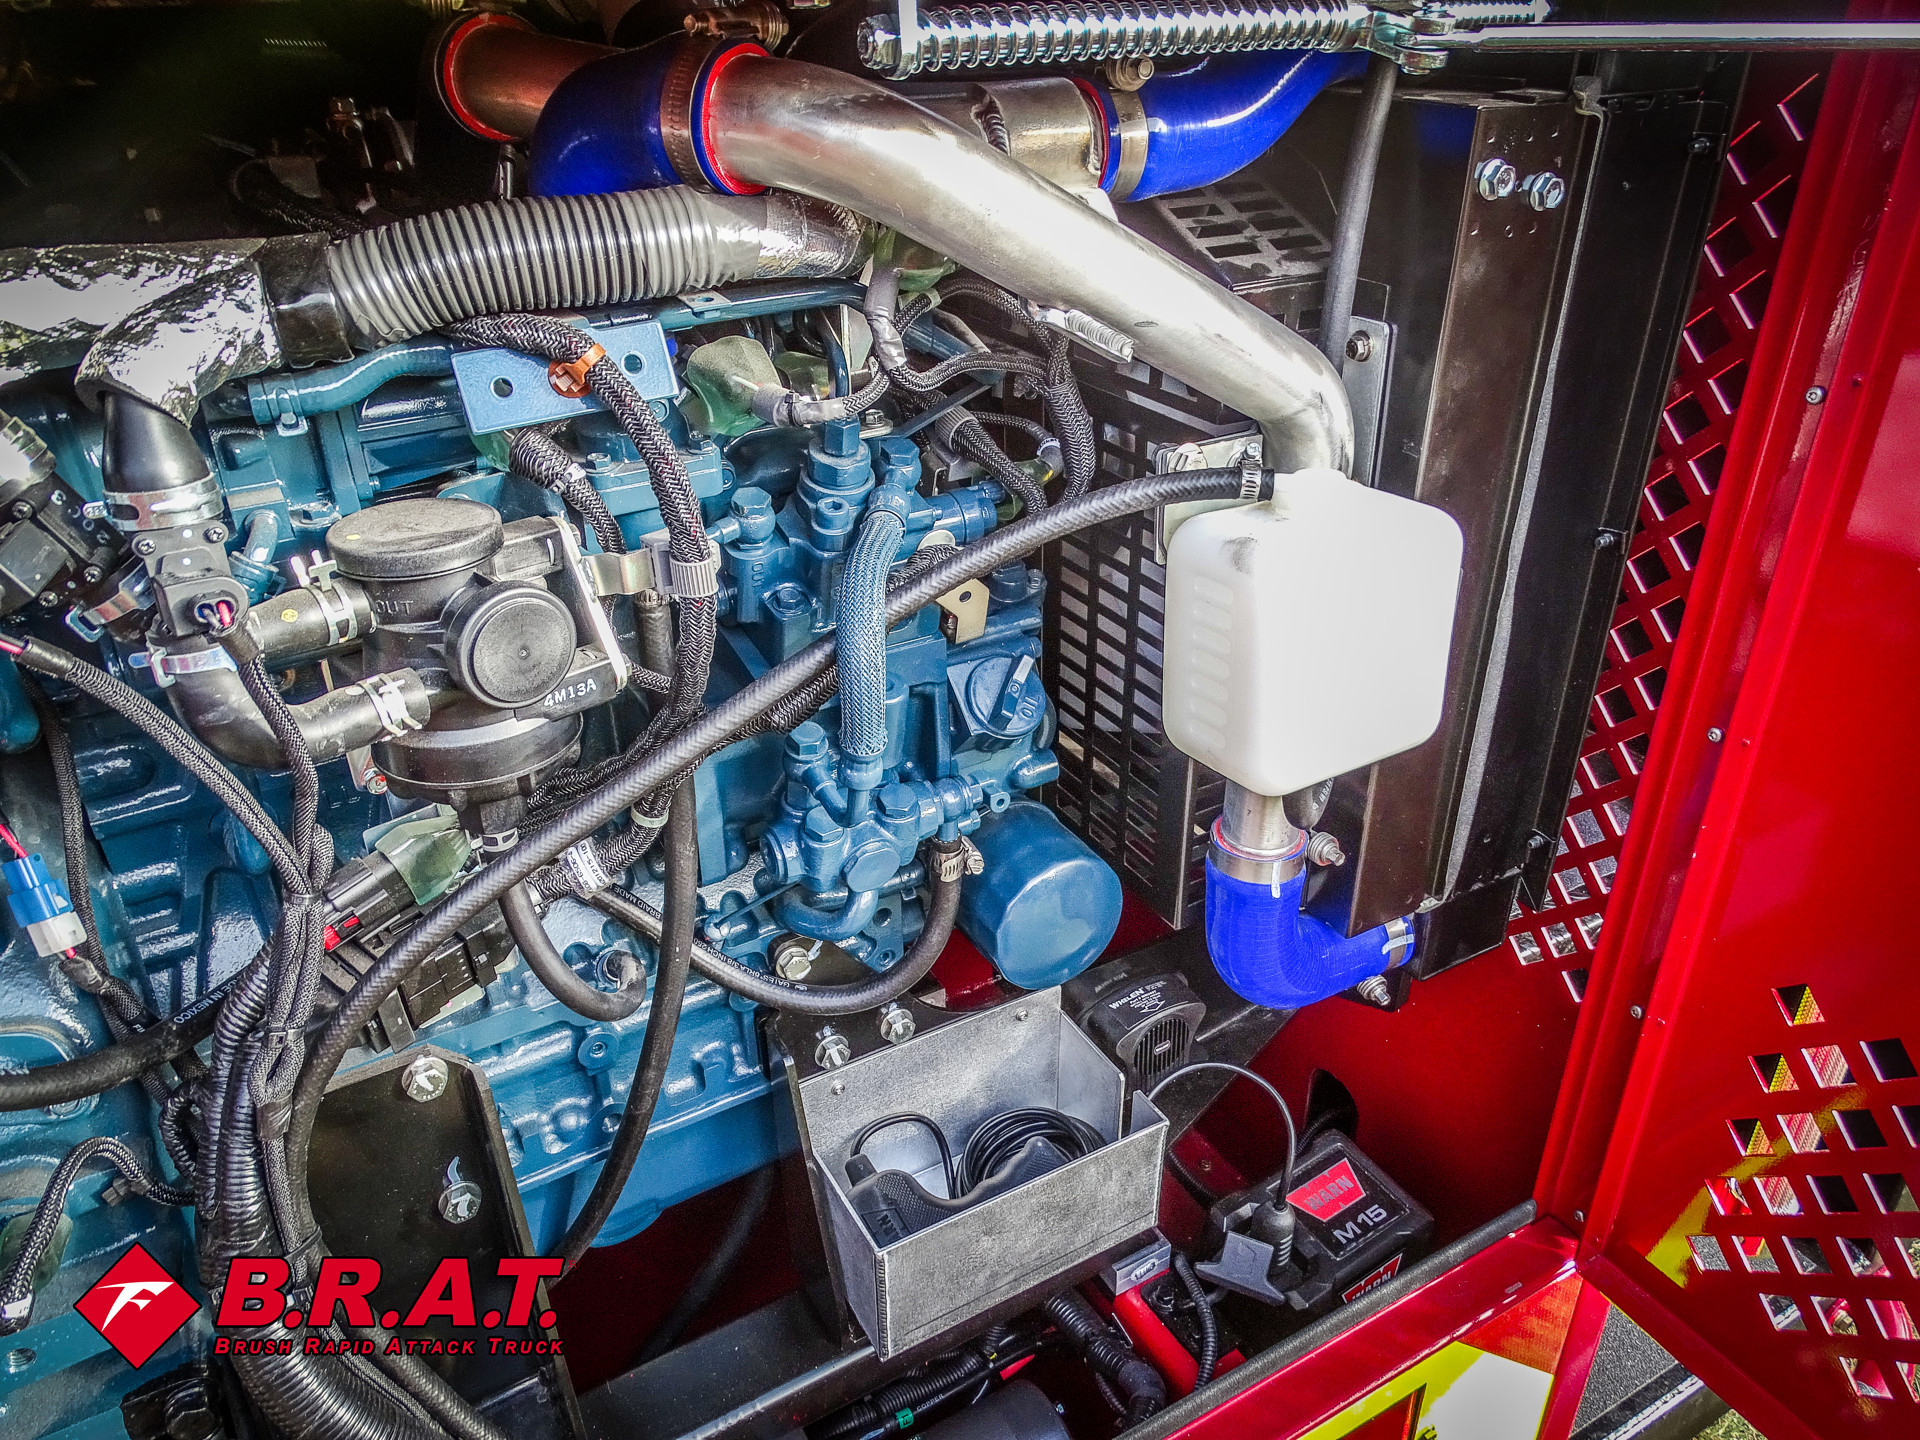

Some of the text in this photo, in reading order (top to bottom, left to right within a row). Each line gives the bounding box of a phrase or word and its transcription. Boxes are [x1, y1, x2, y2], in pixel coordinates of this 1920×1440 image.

[375, 599, 414, 616] OUT
[544, 678, 597, 707] 4M13A
[611, 884, 637, 903] MADE
[635, 899, 662, 919] BRAID
[706, 945, 727, 961] INCH
[725, 957, 740, 969] 3/8
[210, 989, 224, 1002] IN
[1108, 987, 1145, 1010] WHELEN
[173, 998, 214, 1024] MEXICO
[1303, 1175, 1355, 1212] WARN
